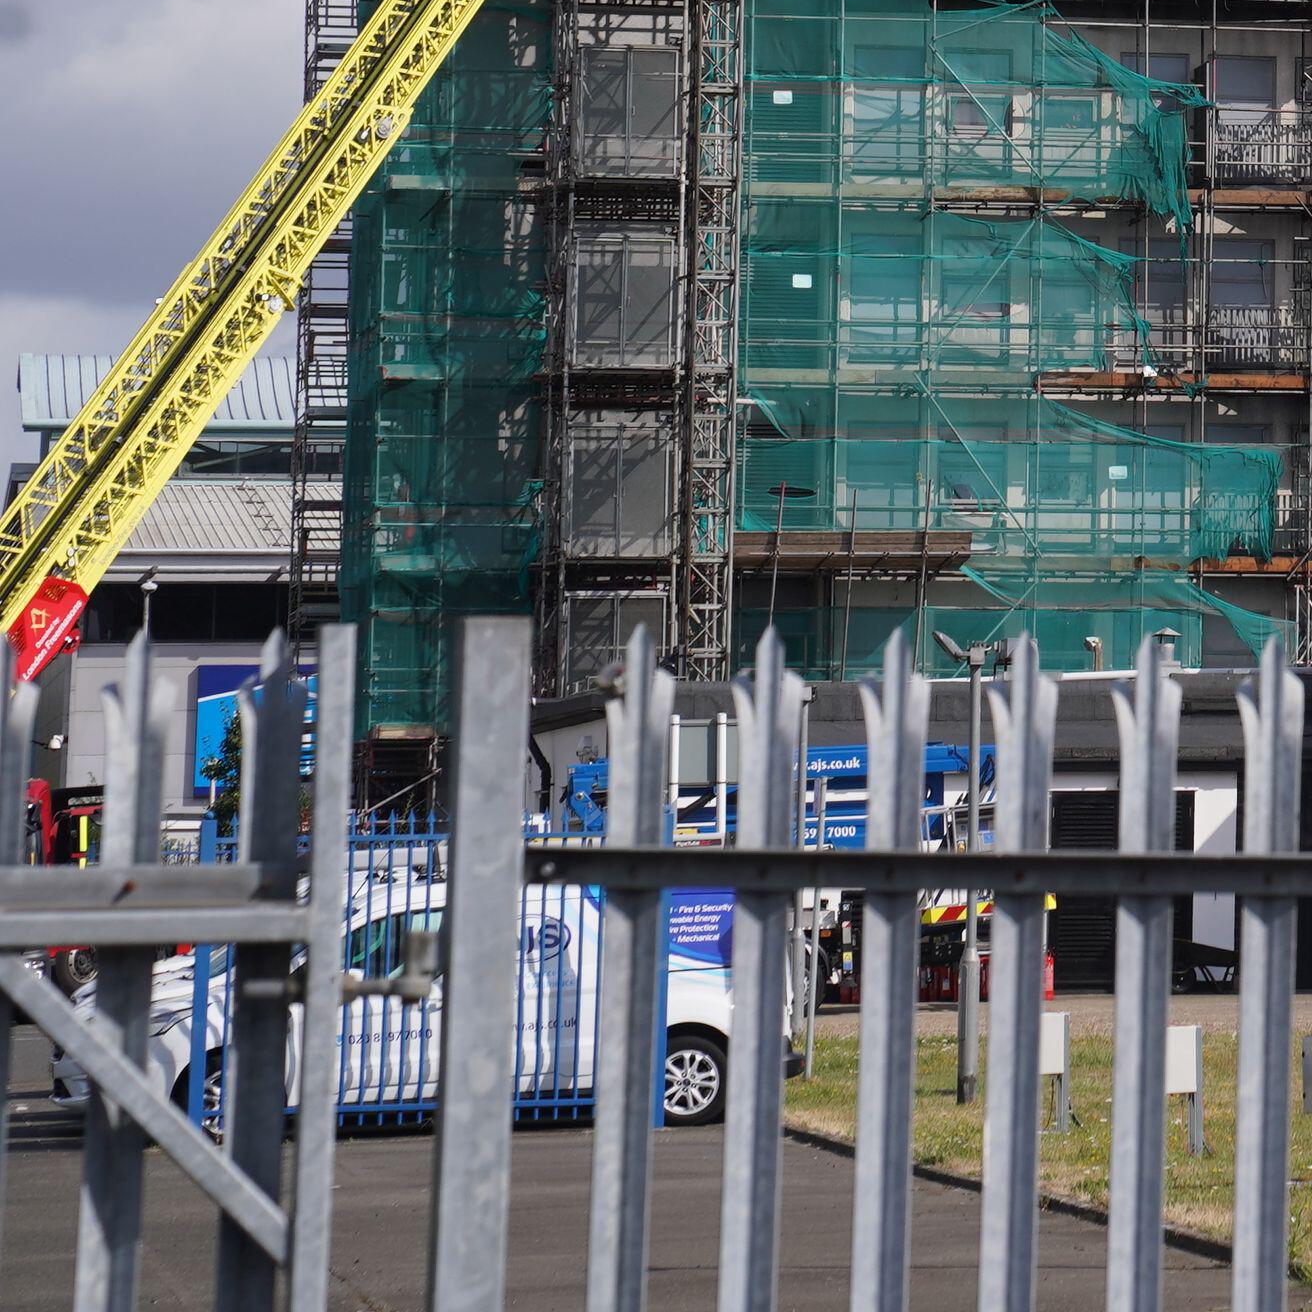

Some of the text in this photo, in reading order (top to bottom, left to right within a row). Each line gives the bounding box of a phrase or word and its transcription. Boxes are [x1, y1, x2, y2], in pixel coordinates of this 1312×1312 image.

[22, 599, 83, 680] London Freemasons
[827, 825, 857, 838] 7000
[678, 905, 694, 914] Fire
[702, 903, 734, 913] Security
[694, 913, 721, 924] Energy
[680, 924, 719, 933] Protection
[677, 933, 721, 944] Mechanical
